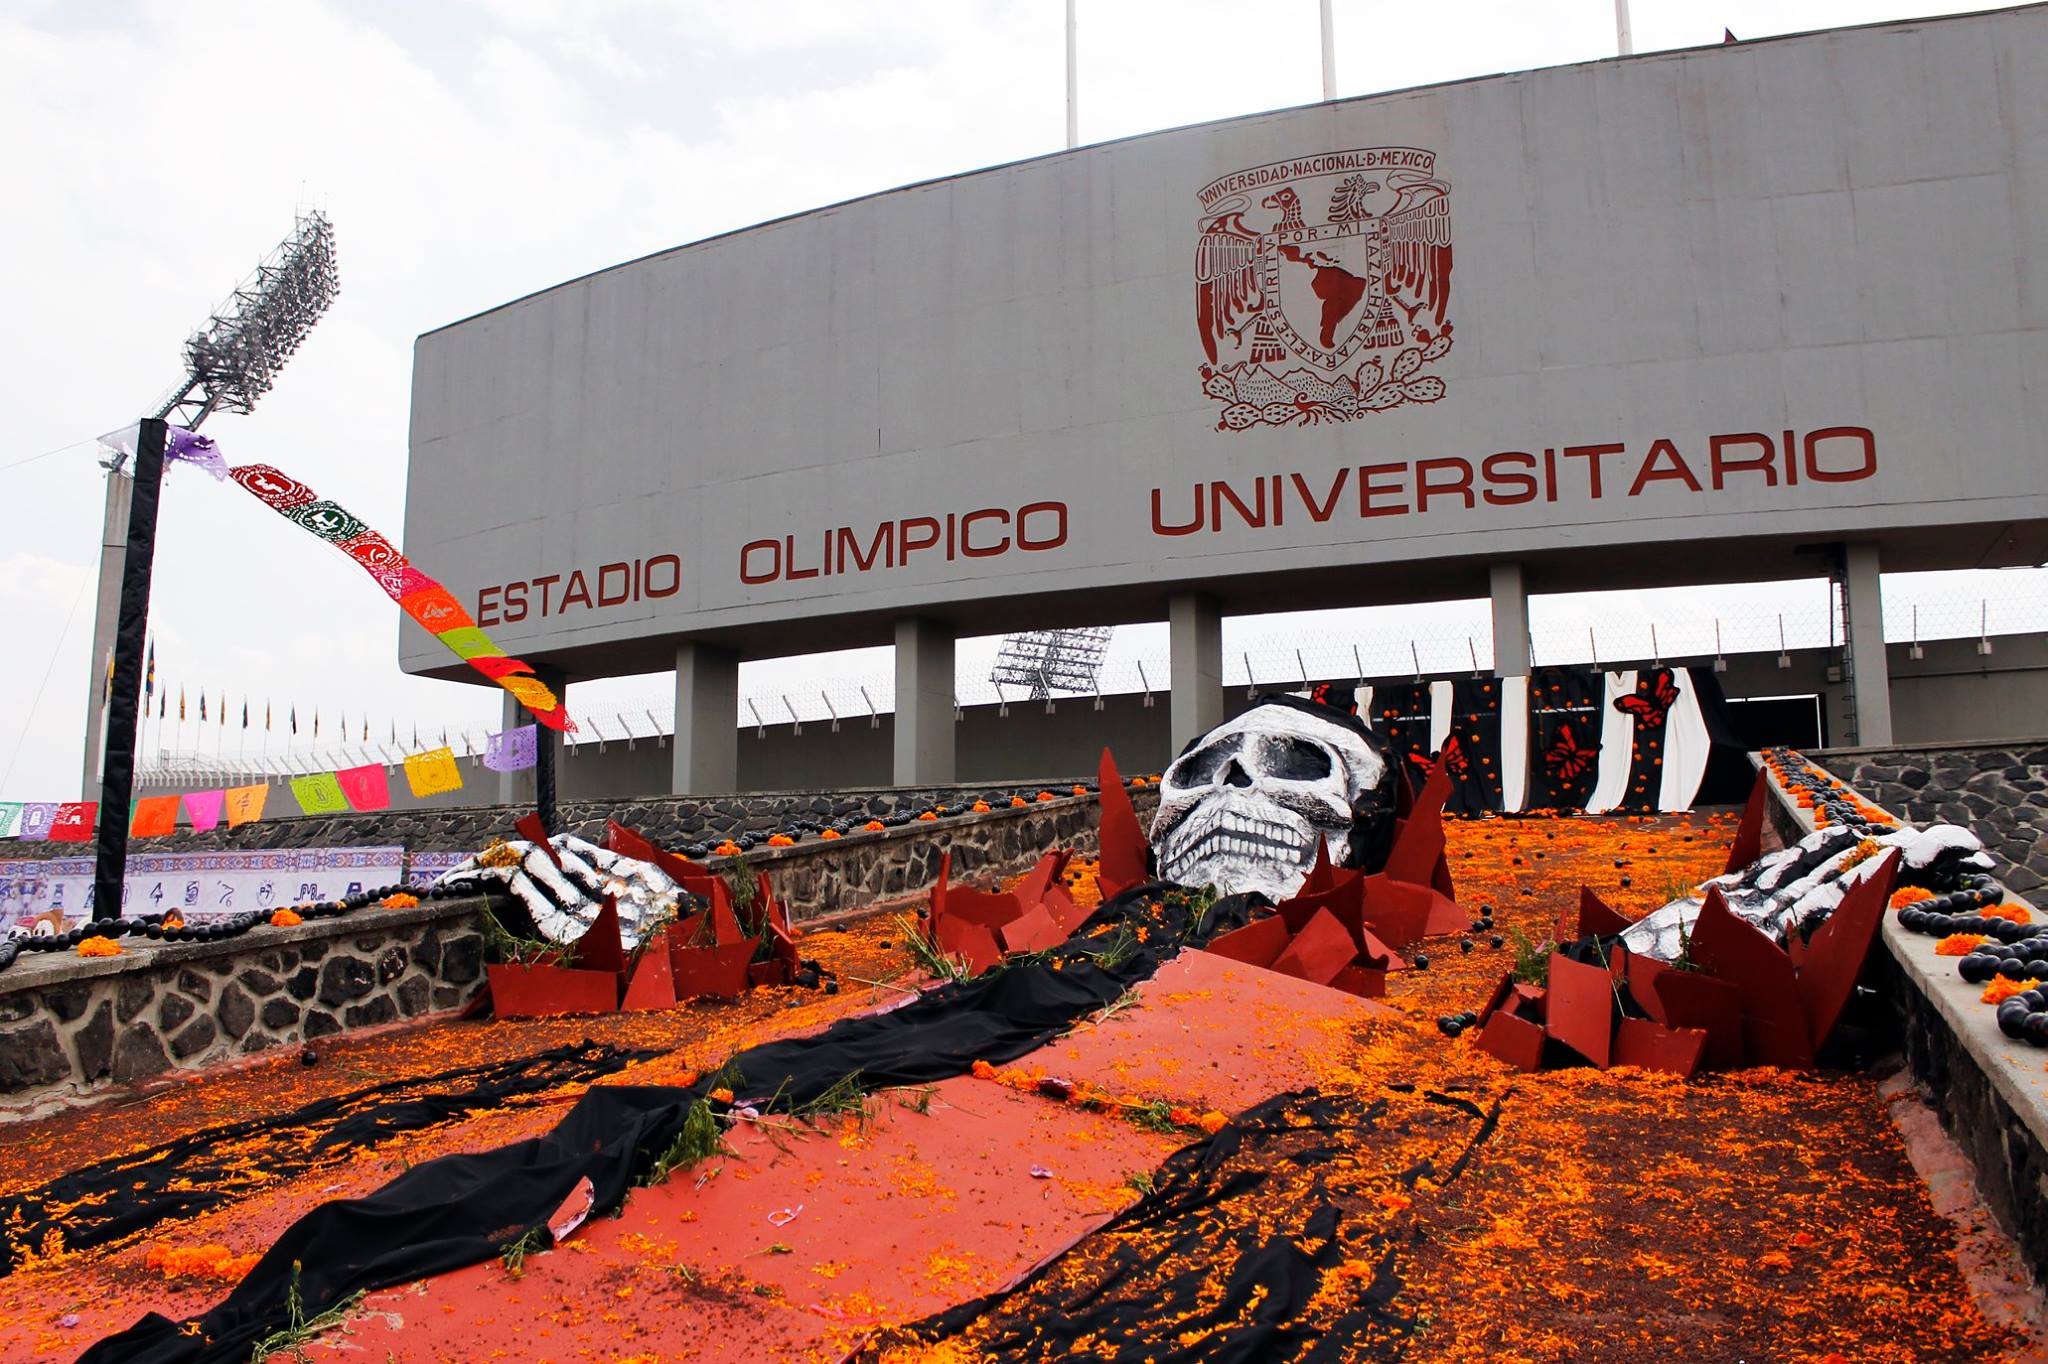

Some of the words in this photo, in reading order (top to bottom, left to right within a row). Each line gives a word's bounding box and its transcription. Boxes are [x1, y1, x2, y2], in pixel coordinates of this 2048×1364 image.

[1293, 153, 1364, 176] NACIONAL
[1380, 151, 1432, 169] MEXICO
[1278, 228, 1318, 244] POR
[1337, 221, 1360, 236] MI
[1367, 231, 1382, 287] RAZA
[1290, 333, 1308, 355] EL
[1312, 295, 1382, 368] HABLARA
[478, 554, 681, 628] ESTADIO
[740, 501, 1068, 585] OLIMPICO
[1151, 425, 1877, 536] UNIVERSITARIO
